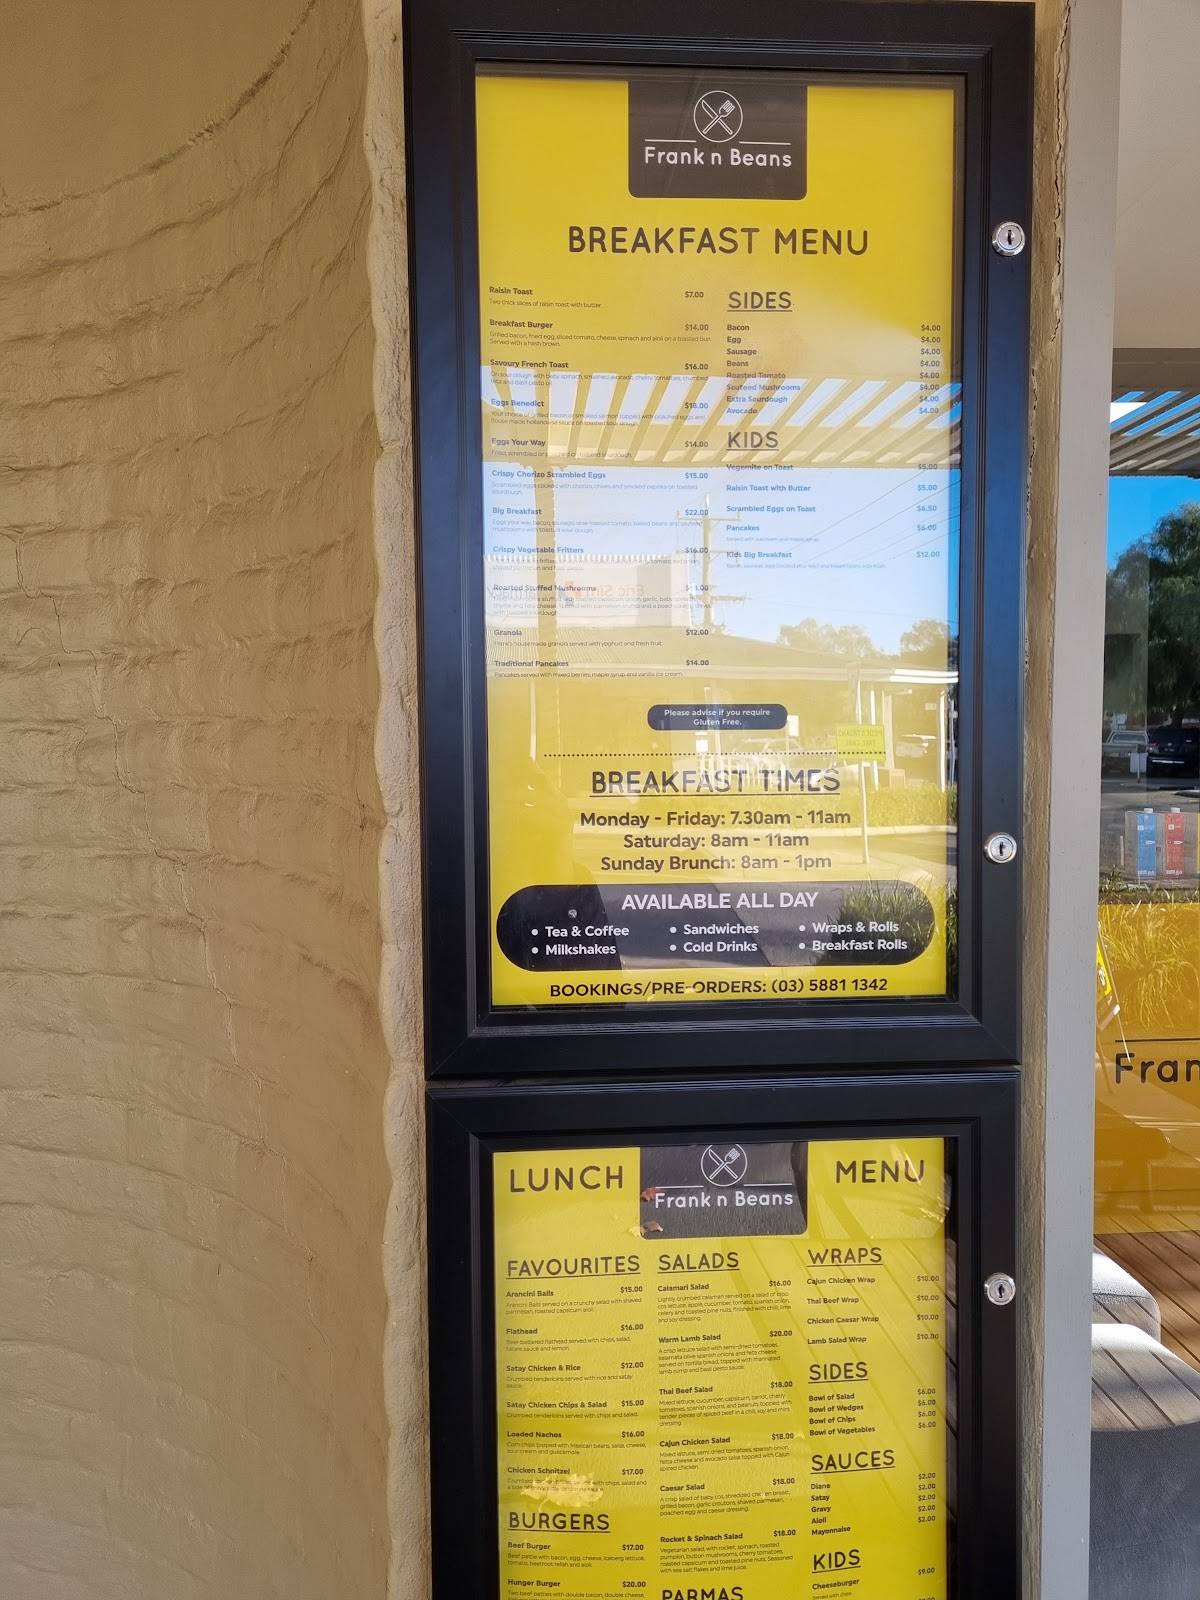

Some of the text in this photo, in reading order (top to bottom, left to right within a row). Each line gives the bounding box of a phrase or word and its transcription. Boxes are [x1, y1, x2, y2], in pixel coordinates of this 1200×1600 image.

[645, 147, 792, 167] Frank n Beans
[569, 226, 868, 255] BREAKFAST MENU
[490, 287, 511, 295] Raisin
[685, 291, 704, 299] $7.00
[729, 291, 792, 309] SIDES
[490, 319, 553, 329] Breakfast Burger
[490, 359, 519, 368] Savoury
[522, 360, 547, 368] French
[728, 431, 778, 448] KIDS
[492, 470, 514, 479] Crispy
[719, 708, 724, 716] if
[726, 710, 740, 718] you
[742, 709, 771, 717] require
[592, 769, 841, 793] BREAKFAST TIMES
[580, 810, 851, 829] Monday Friday: 7.30am 11am
[624, 833, 809, 851] Saturday: 8am 11am
[601, 855, 832, 873] Sunday Brunch: 8am 1pm
[622, 893, 818, 910] AVAILABLE ALL DAY
[545, 924, 629, 937] Tea & Coffee
[684, 923, 759, 935] Sandwiches
[812, 921, 899, 936] Wraps & Rolls
[546, 944, 616, 956] Milkshakes
[684, 940, 757, 953] Cold Drinks
[812, 939, 907, 951] Breakfast Rolls
[550, 978, 887, 997] BOOKINGS/PRE-ORDERS: (03) 5881 1342
[1115, 1053, 1200, 1084] Fran
[510, 1165, 624, 1193] LUNCH
[835, 1159, 925, 1185] MENU
[655, 1191, 793, 1209] Frank n Beans
[659, 1252, 739, 1270] SALADS
[808, 1247, 882, 1264] WRAPS
[508, 1255, 640, 1276] FAVOURITES
[810, 1362, 868, 1380] SIDES
[837, 1427, 875, 1435] Vegetables
[812, 1450, 895, 1471] SAUCES
[509, 1512, 610, 1530] BURGERS
[695, 1534, 722, 1542] Spinach
[812, 1526, 851, 1535] Mayonnaise
[814, 1549, 860, 1570] KIDS
[812, 1579, 859, 1590] Cheeseburger
[662, 1587, 743, 1600] PARMAS
